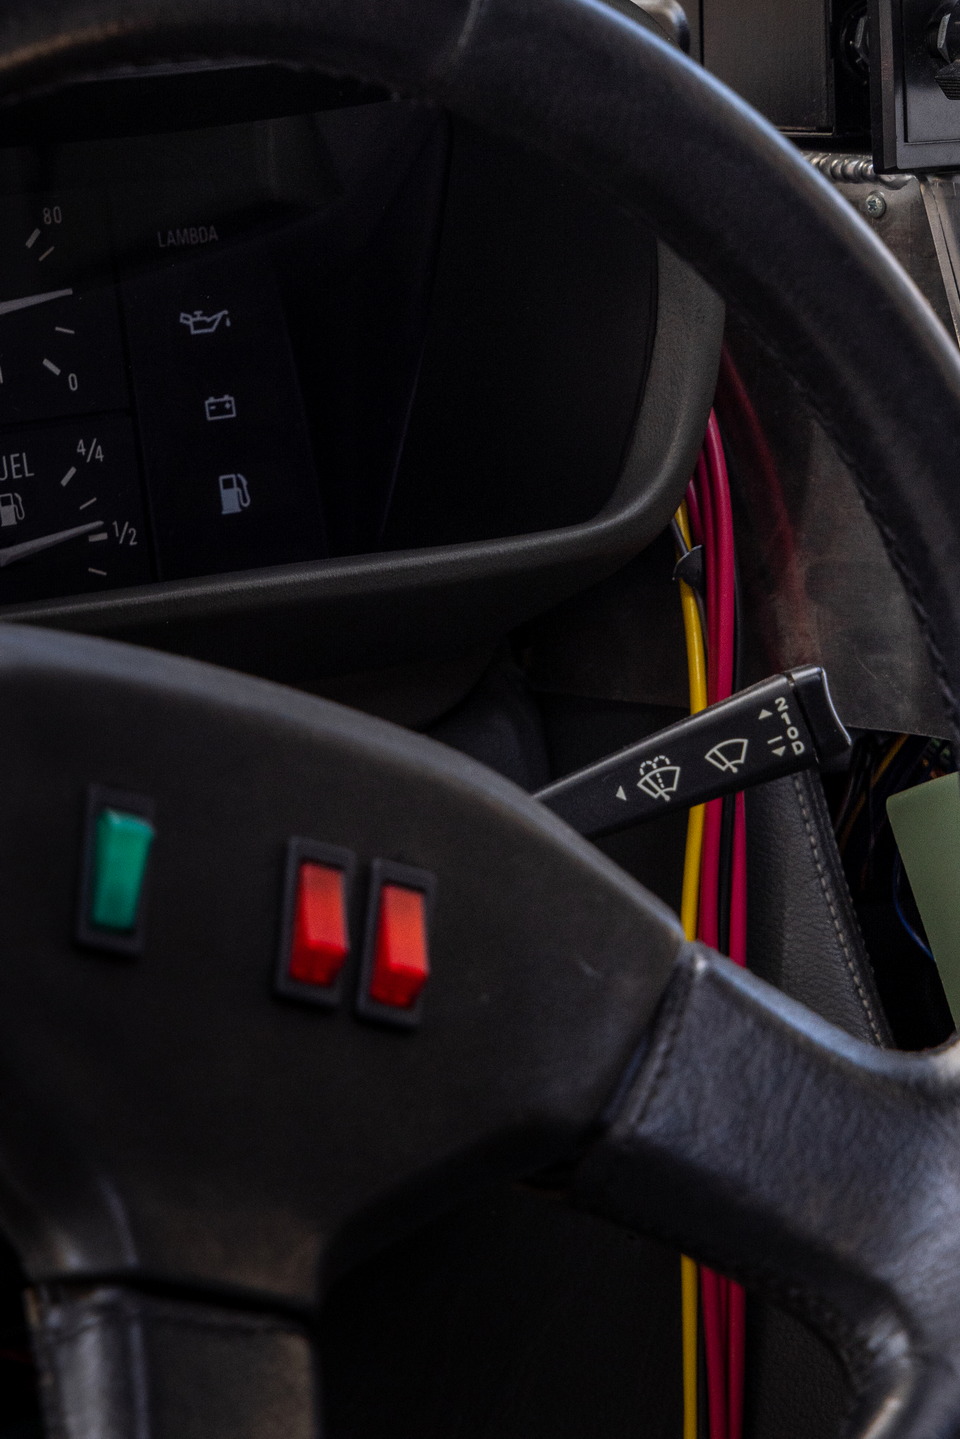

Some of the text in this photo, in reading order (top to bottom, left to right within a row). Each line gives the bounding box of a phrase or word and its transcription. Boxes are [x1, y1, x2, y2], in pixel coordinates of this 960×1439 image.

[42, 206, 62, 225] 80
[157, 224, 219, 248] LAMBDA
[68, 373, 78, 391] 0
[76, 438, 104, 463] 4/4
[0, 452, 35, 481] UEL
[112, 521, 138, 546] 1/2
[774, 696, 788, 711] 2
[781, 713, 791, 724] 1
